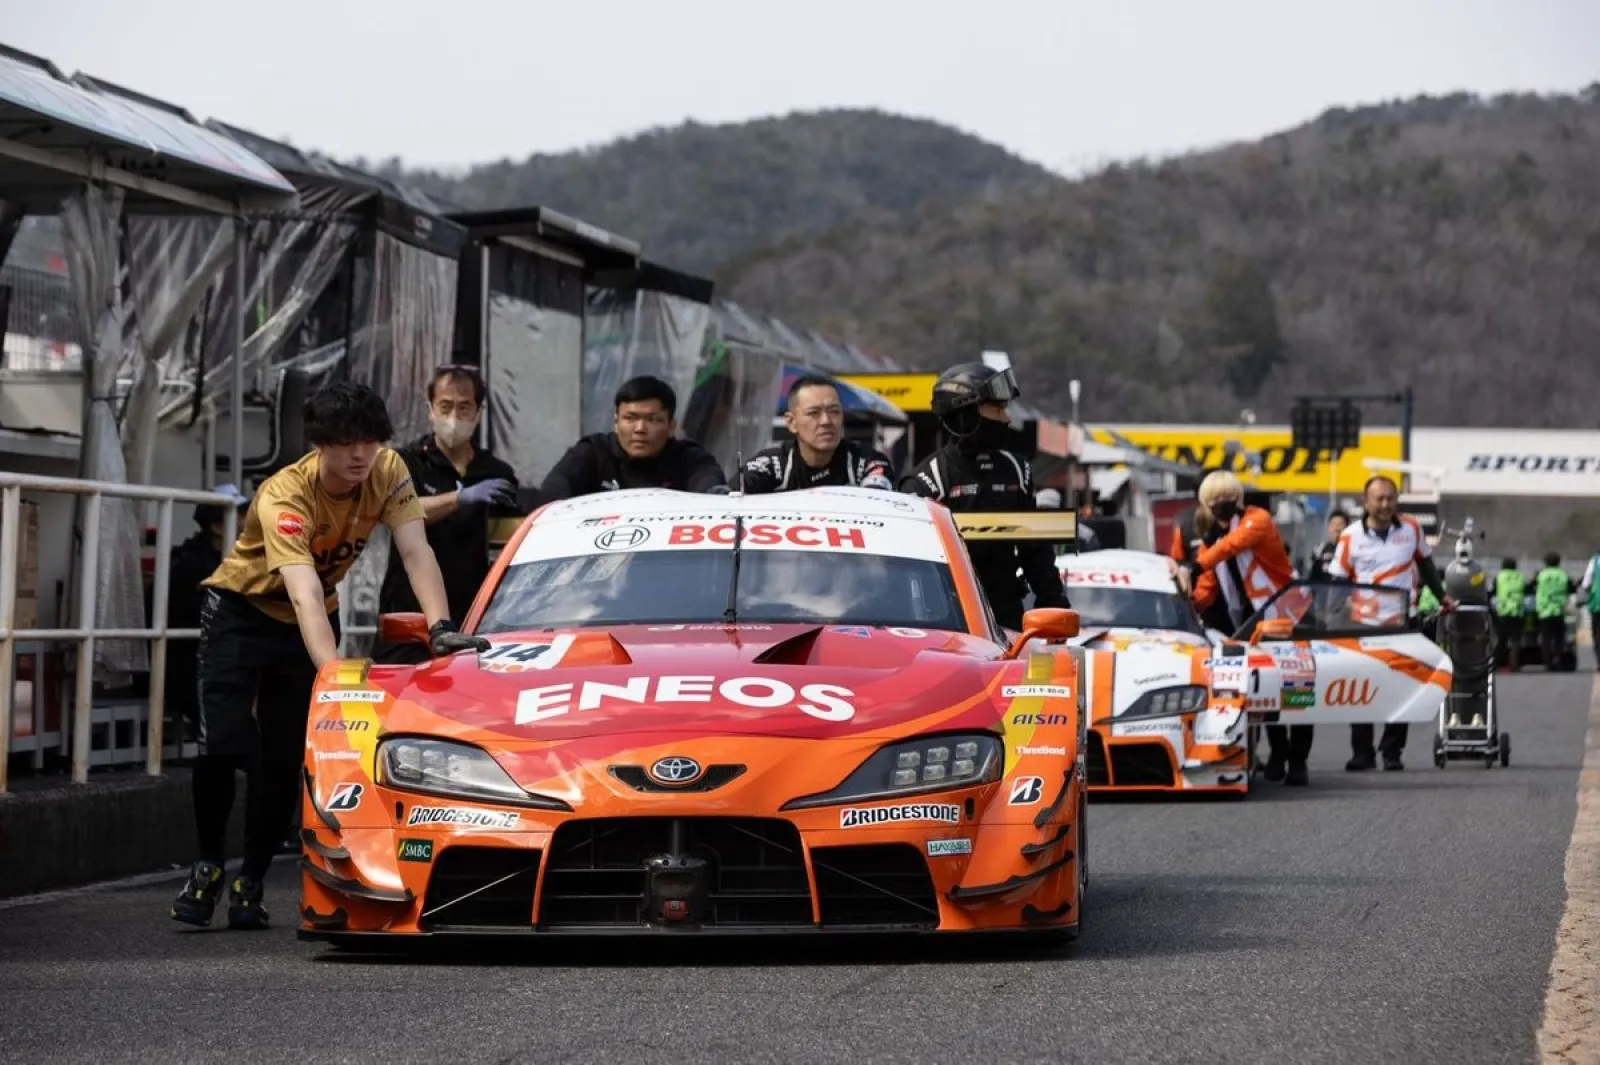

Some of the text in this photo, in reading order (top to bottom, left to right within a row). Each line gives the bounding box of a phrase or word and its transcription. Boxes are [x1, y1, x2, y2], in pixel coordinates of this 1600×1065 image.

[668, 524, 866, 549] BOSCH
[482, 643, 552, 662] 14
[1251, 668, 1260, 694] 1
[514, 676, 855, 726] ENEOS
[1325, 677, 1380, 707] au
[316, 720, 369, 731] AISIN
[1012, 714, 1068, 725] AISIN
[1016, 746, 1066, 755] ThreeBond
[408, 807, 518, 828] BRIDGESTONE
[843, 805, 960, 827] BRIDGESTONE
[404, 844, 432, 858] SMBC
